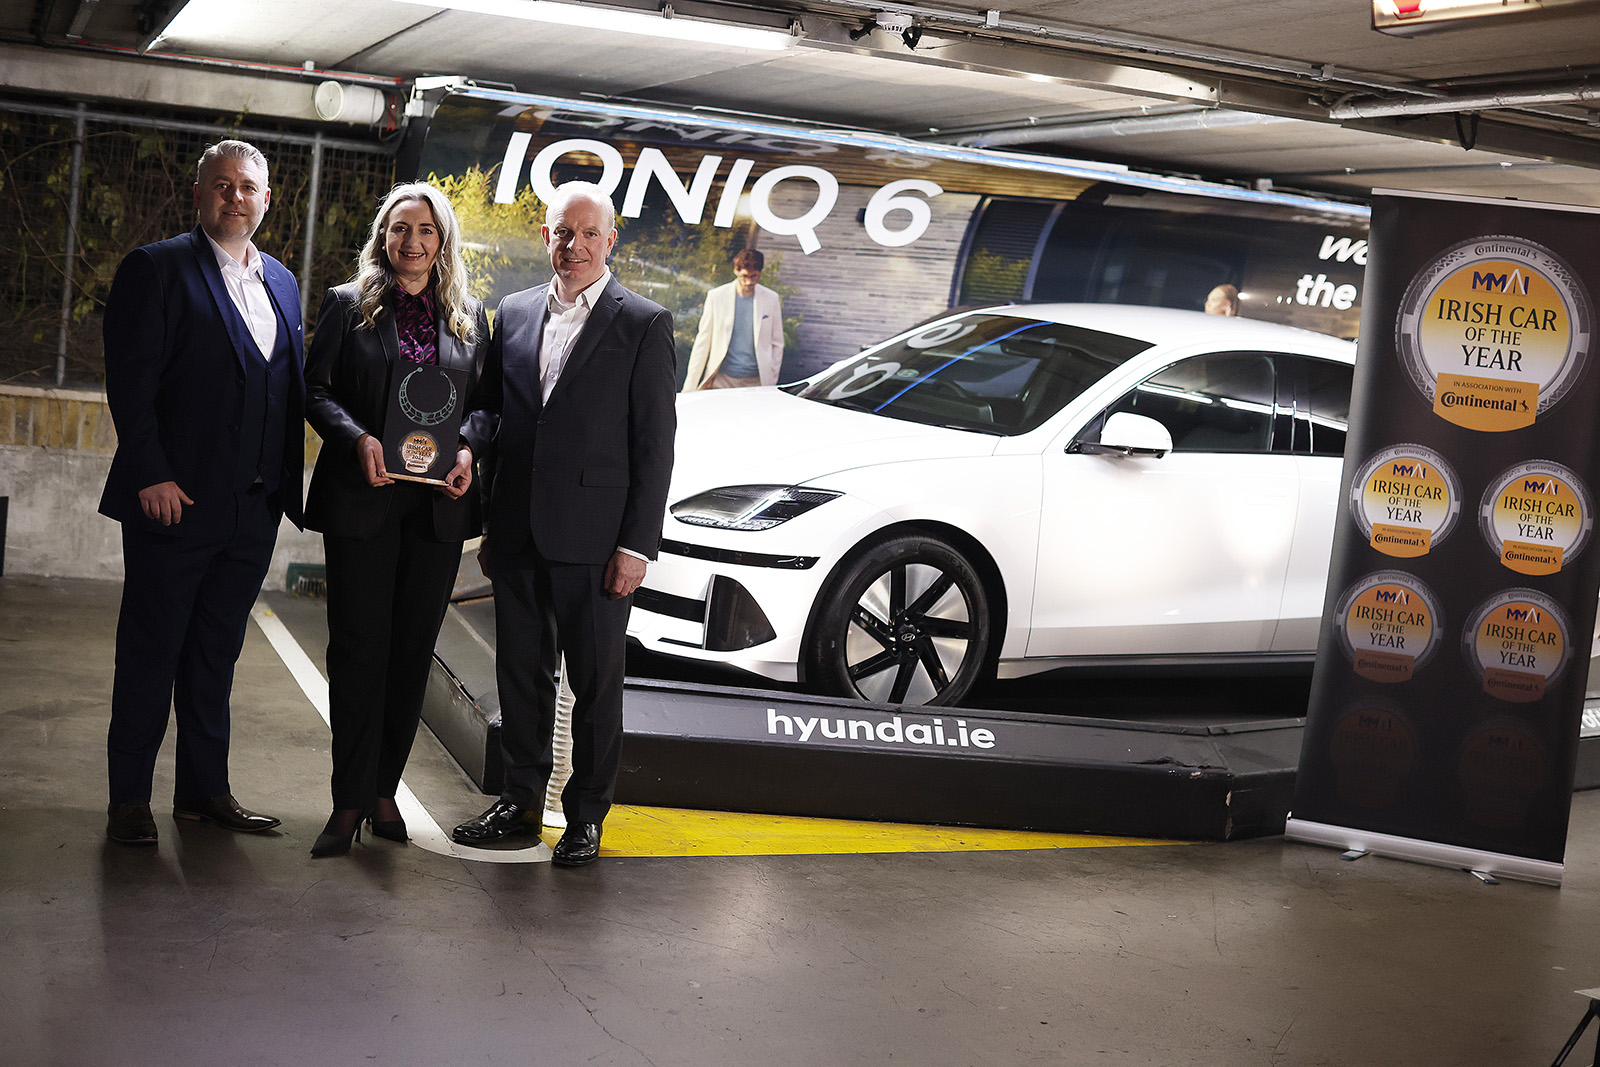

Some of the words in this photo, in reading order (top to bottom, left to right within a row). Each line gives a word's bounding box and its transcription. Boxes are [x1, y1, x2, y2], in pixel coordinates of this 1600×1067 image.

[495, 131, 839, 255] IONIQ
[864, 179, 944, 247] 6
[1474, 243, 1531, 258] Continental
[1438, 298, 1503, 326] IRISH
[1509, 306, 1557, 332] CAR
[1465, 327, 1487, 342] OF
[1491, 329, 1522, 346] THE
[1461, 345, 1522, 372] YEAR
[1461, 382, 1504, 392] ASSOCIATION
[1504, 386, 1522, 394] WITH
[1440, 391, 1517, 412] Continental
[1373, 479, 1410, 496] IRISH
[1414, 484, 1442, 500] CAR
[1388, 496, 1401, 505] OF
[1403, 498, 1421, 508] THE
[1504, 496, 1542, 513] IRISH
[1546, 502, 1575, 517] CAR
[1387, 506, 1422, 523] YEAR
[1519, 512, 1532, 522] OF
[1534, 514, 1553, 525] THE
[1374, 533, 1419, 546] Continental
[1518, 523, 1554, 540] YEAR
[1505, 551, 1551, 564] Continental
[1356, 605, 1393, 622] IRISH
[1397, 611, 1425, 627] CAR
[1371, 622, 1384, 631] OF
[1386, 624, 1405, 634] THE
[1486, 623, 1525, 640] IRISH
[1528, 629, 1557, 646] CAR
[1370, 632, 1405, 649] YEAR
[1501, 640, 1515, 650] OF
[1517, 642, 1536, 654] THE
[1500, 650, 1536, 668] YEAR
[766, 708, 996, 750] hyundai.ie
